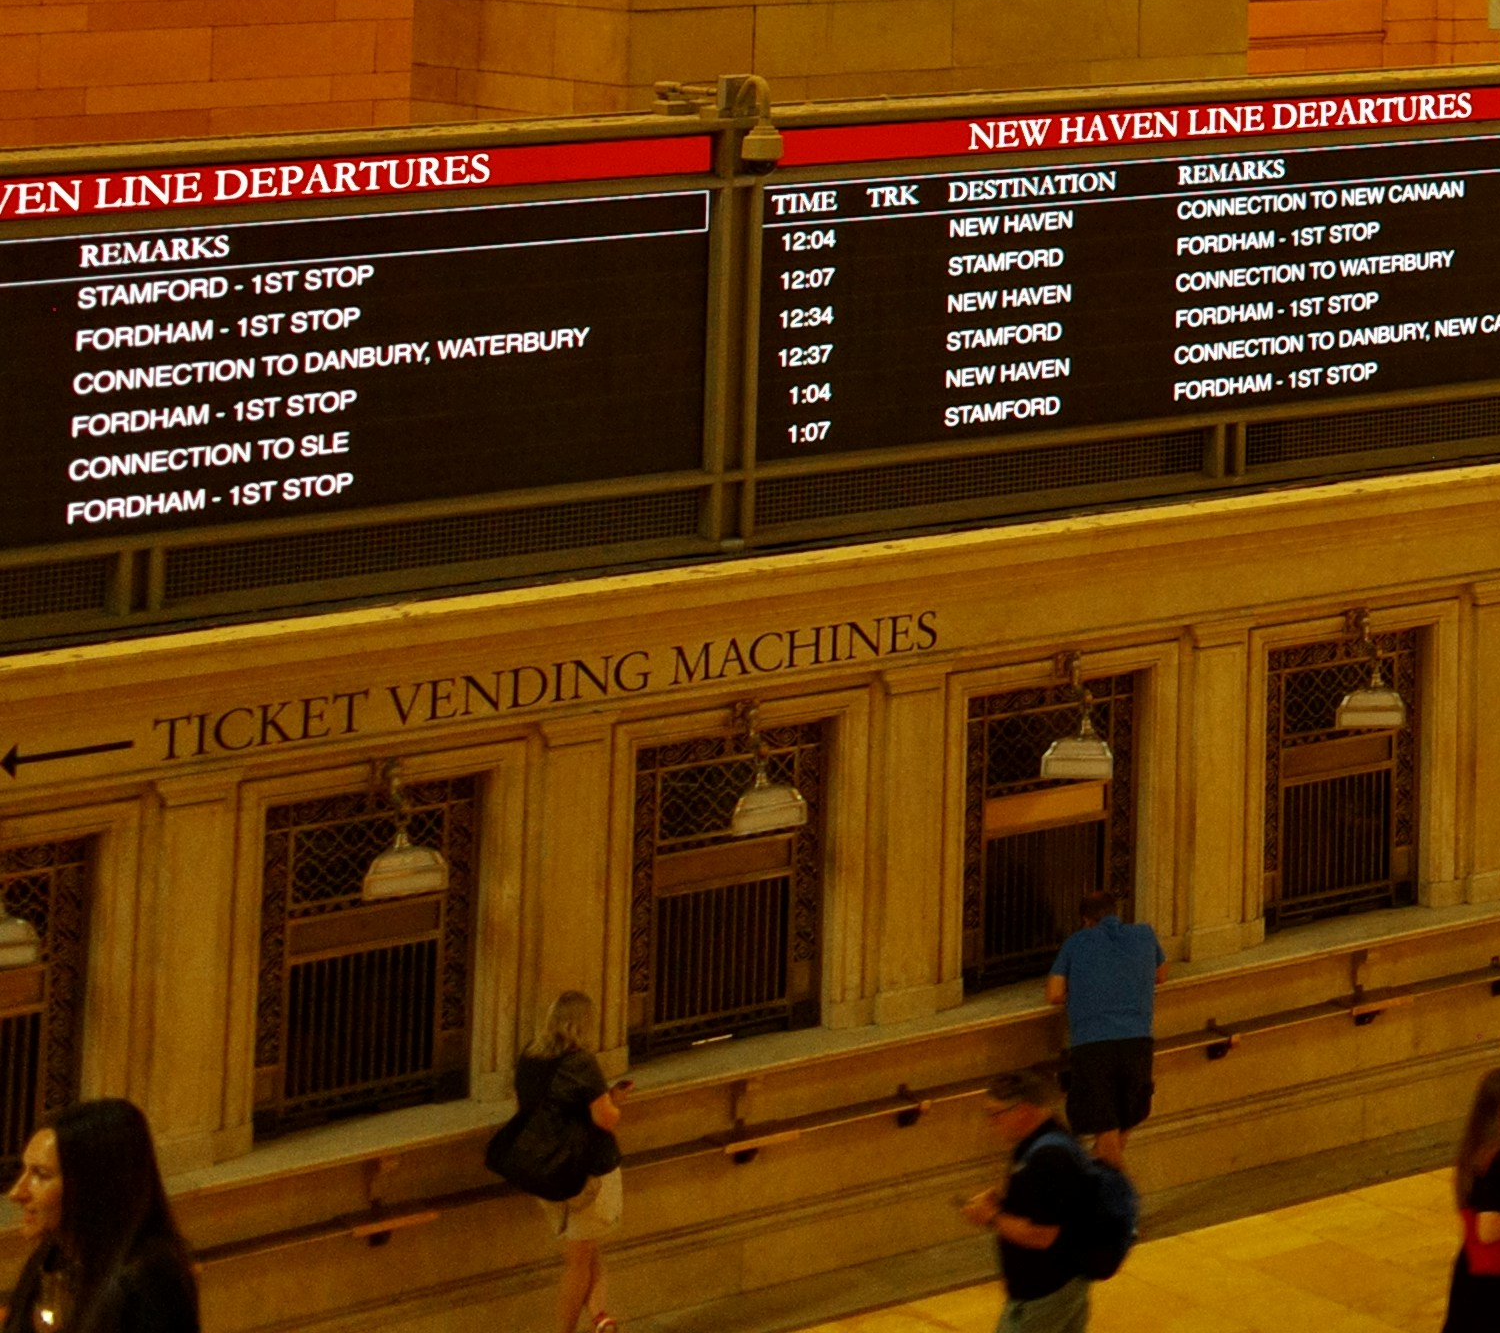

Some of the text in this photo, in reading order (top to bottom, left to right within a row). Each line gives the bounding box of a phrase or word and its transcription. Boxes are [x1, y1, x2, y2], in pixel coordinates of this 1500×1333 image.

[968, 93, 1472, 150] NEW HAVEN LINE DEPARTURES
[94, 173, 202, 208] LINE
[214, 154, 490, 200] DEPARTURES
[948, 171, 1116, 202] DESTINATION
[1178, 159, 1285, 185] REMARKS
[772, 191, 837, 215] TIME
[866, 185, 919, 207] TRK
[1177, 180, 1464, 220] CONNECTION TO NEW CANAAN
[782, 229, 836, 251] 12:04
[950, 210, 1073, 238] NEW HAVEN
[1177, 230, 1274, 256] FORDHAM
[1291, 226, 1326, 246] 1ST
[1329, 222, 1380, 243] STOP
[80, 235, 229, 268] REMARKS
[948, 248, 1064, 276] STAMFORD
[78, 277, 228, 309] STAMFORD
[252, 271, 299, 294] 1ST
[304, 265, 374, 290] STOP
[781, 268, 835, 290] 12:07
[1176, 250, 1454, 292] CONNECTION TO WATERBURY
[948, 284, 1071, 313] NEW HAVEN
[76, 320, 213, 351] FORDHAM
[238, 313, 285, 337] 1ST
[291, 307, 360, 333] STOP
[780, 306, 834, 328] 12:34
[1174, 335, 1303, 364] CONNECTION
[1307, 331, 1334, 350] TO
[1339, 322, 1430, 348] DANBURY,
[1435, 317, 1478, 337] NEW
[73, 327, 590, 394] CONNECTION TO DANBURY, WATERBURY
[946, 358, 1070, 388] NEW HAVEN
[790, 383, 831, 404] 1:04
[72, 404, 209, 438] FORDHAM
[234, 397, 282, 421] 1ST
[287, 390, 357, 416] STOP
[69, 432, 349, 481] CONNECTION TO SLE
[68, 489, 205, 524] FORDHAM
[230, 481, 278, 505] 1ST
[283, 473, 353, 500] STOP
[153, 610, 938, 761] TICKET VENDING MACHINES
